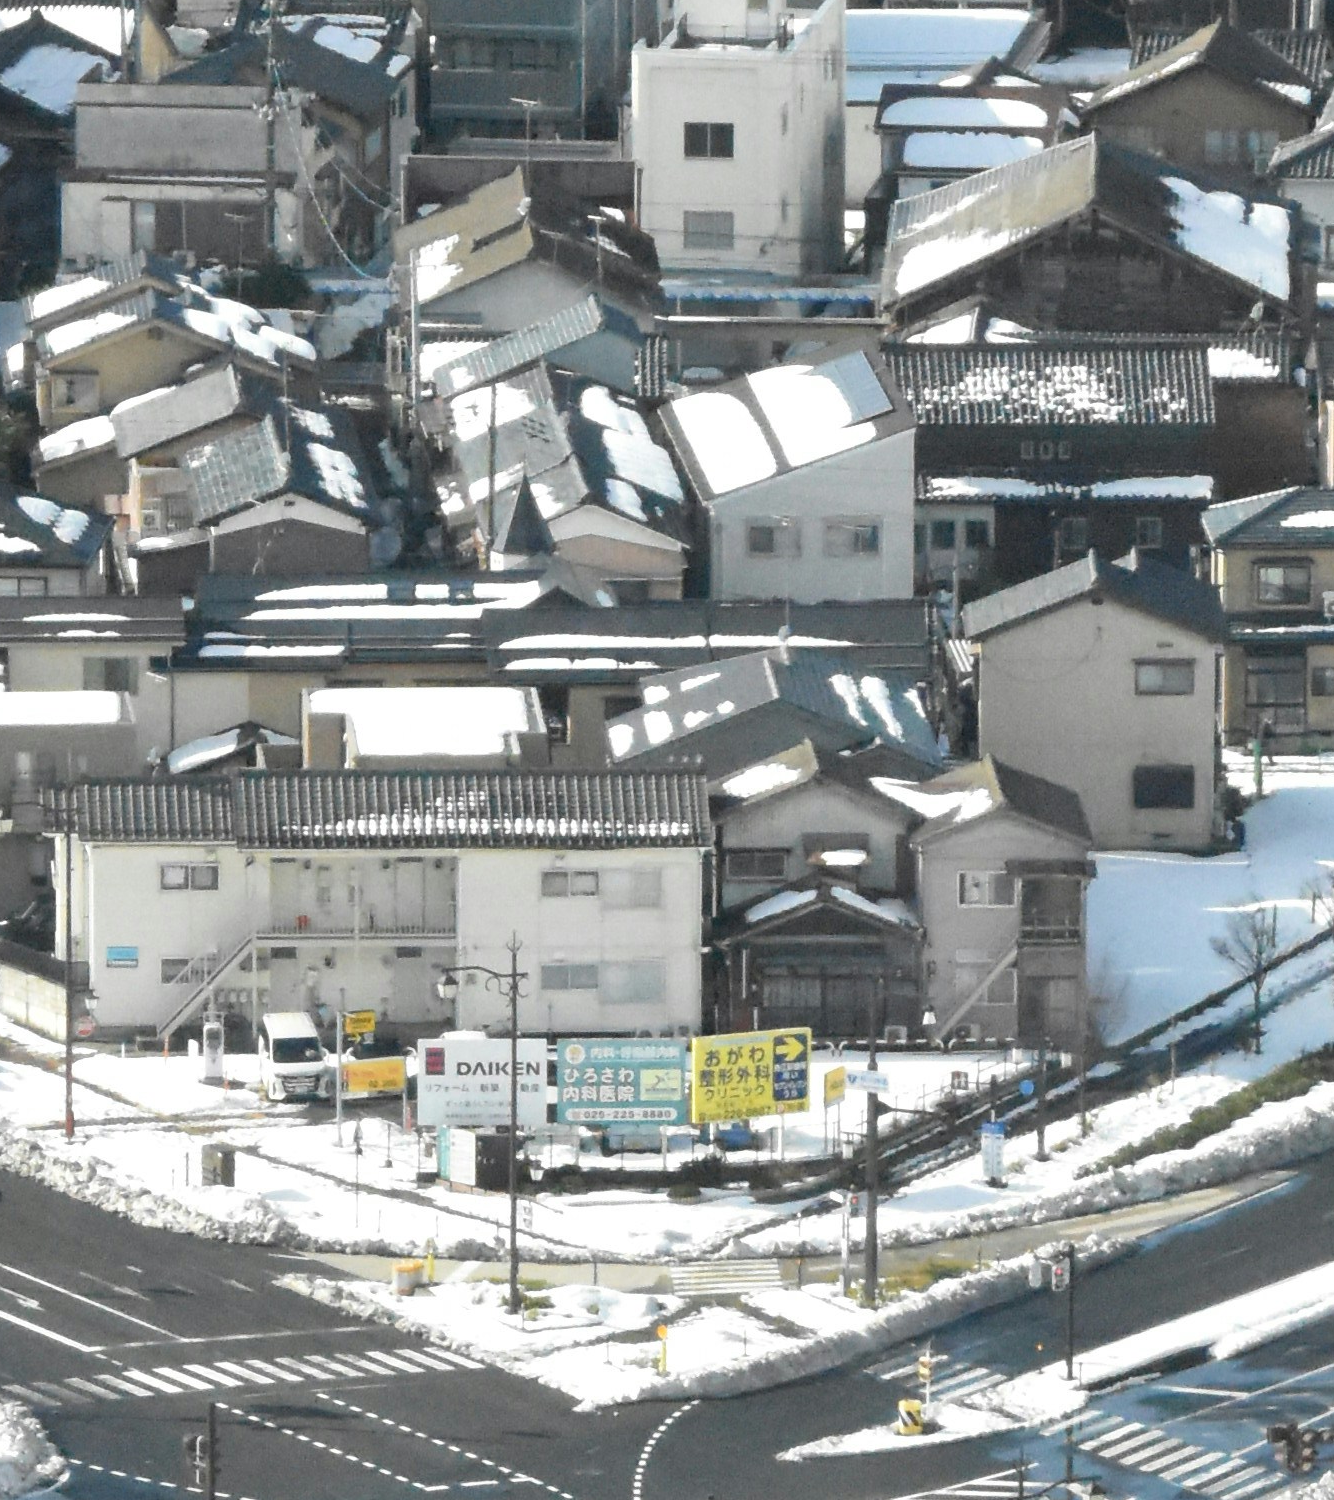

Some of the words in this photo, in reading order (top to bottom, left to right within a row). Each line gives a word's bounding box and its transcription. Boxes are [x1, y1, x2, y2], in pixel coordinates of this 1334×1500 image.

[704, 1045, 766, 1068] おがわ
[456, 1061, 540, 1076] DAIKEN
[563, 1066, 635, 1083] ひろさわ
[698, 1064, 771, 1088] 整形外科
[562, 1084, 635, 1102] 内科医院
[704, 1084, 766, 1101] クリニック
